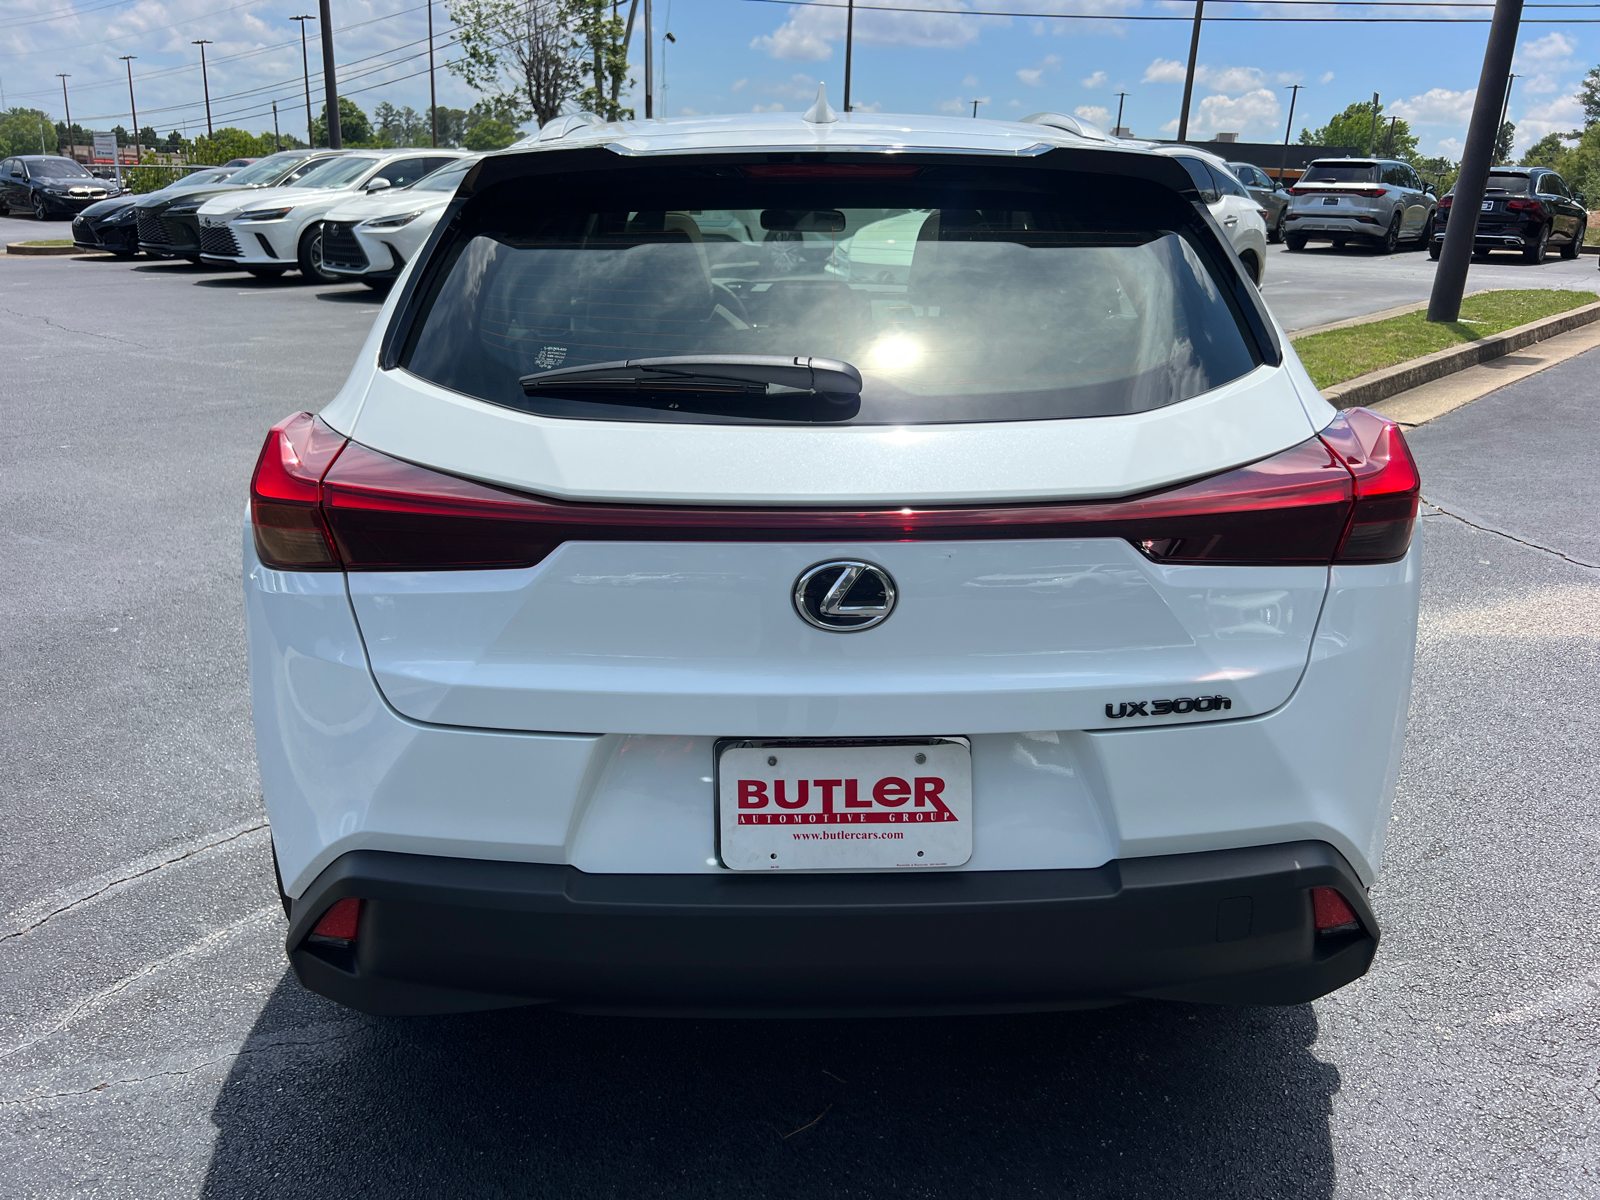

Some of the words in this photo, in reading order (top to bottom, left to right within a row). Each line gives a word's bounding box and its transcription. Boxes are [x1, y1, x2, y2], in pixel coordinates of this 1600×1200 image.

[739, 813, 867, 824] AUTOMOTIVE
[888, 811, 950, 823] GROUP
[793, 830, 904, 841] www.butlercars.com
